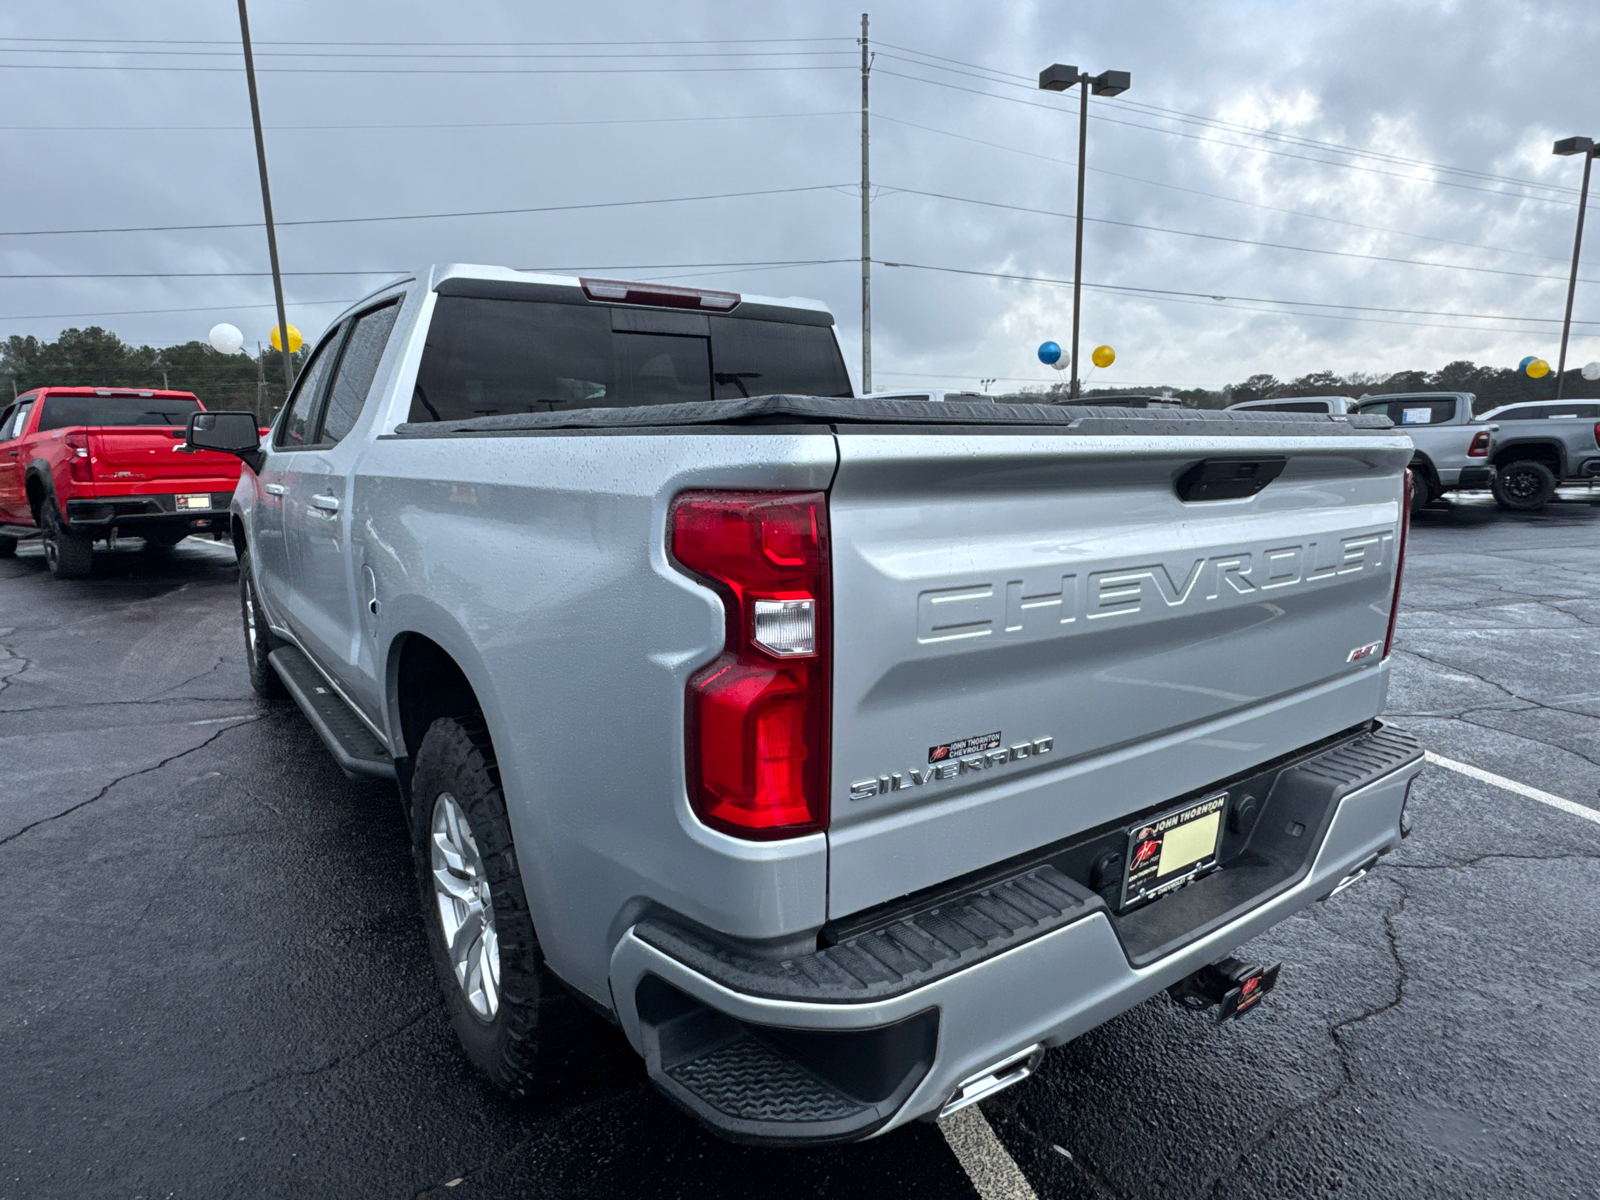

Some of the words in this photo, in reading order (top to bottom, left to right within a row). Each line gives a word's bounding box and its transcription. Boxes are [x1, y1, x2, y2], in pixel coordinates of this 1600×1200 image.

[916, 529, 1394, 644] CHEVROLET
[948, 742, 988, 759] CHEVROLET
[949, 740, 967, 752] JOHN
[968, 732, 1001, 748] THORNTON
[849, 736, 1054, 801] SILVERADO
[1155, 815, 1178, 832] JOHN
[1180, 797, 1225, 822] THORNTON
